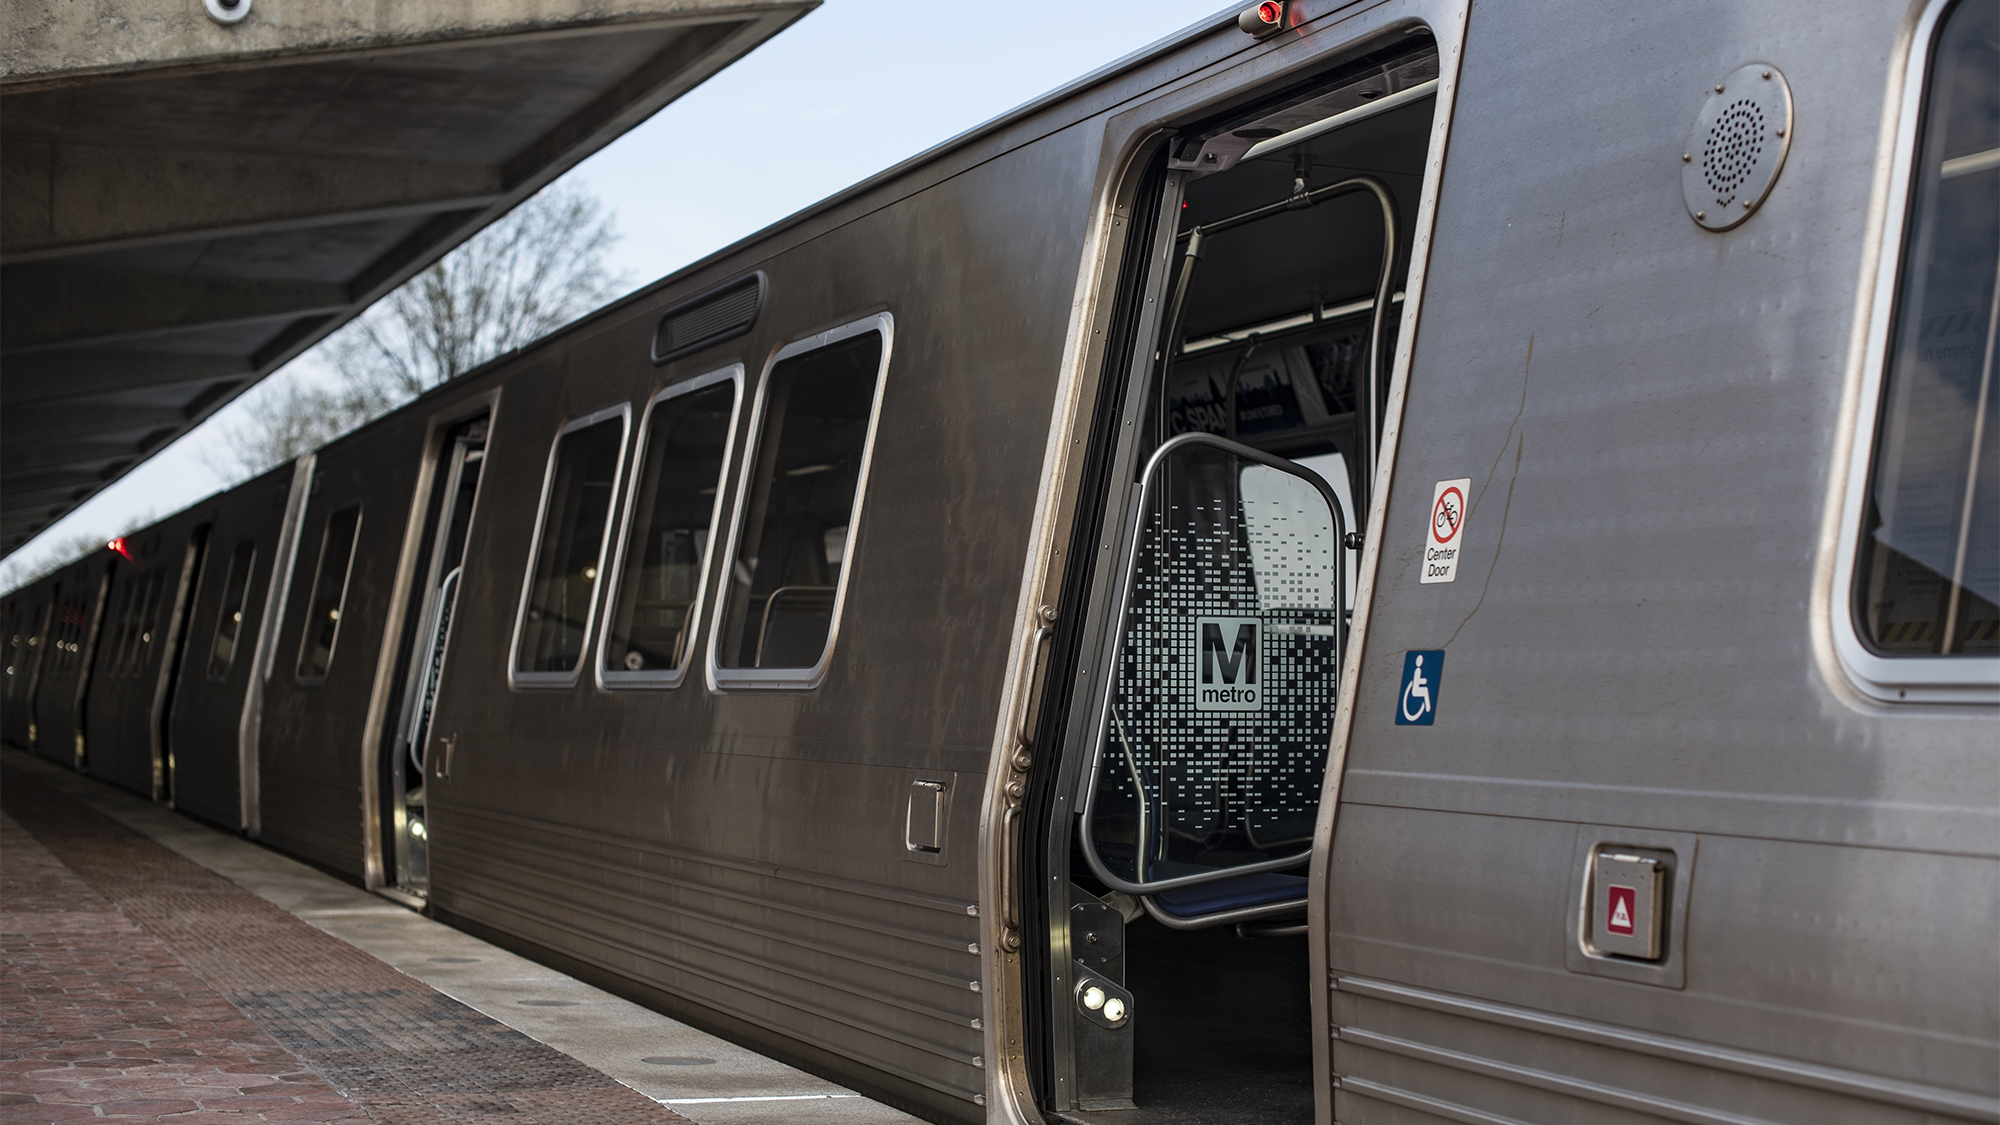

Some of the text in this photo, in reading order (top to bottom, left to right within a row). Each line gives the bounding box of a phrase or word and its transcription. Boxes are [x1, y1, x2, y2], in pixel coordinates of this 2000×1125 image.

[1936, 343, 1976, 360] emerg
[1427, 547, 1457, 561] Center
[1428, 564, 1450, 577] Door
[1202, 623, 1257, 684] M
[1202, 686, 1256, 703] metro
